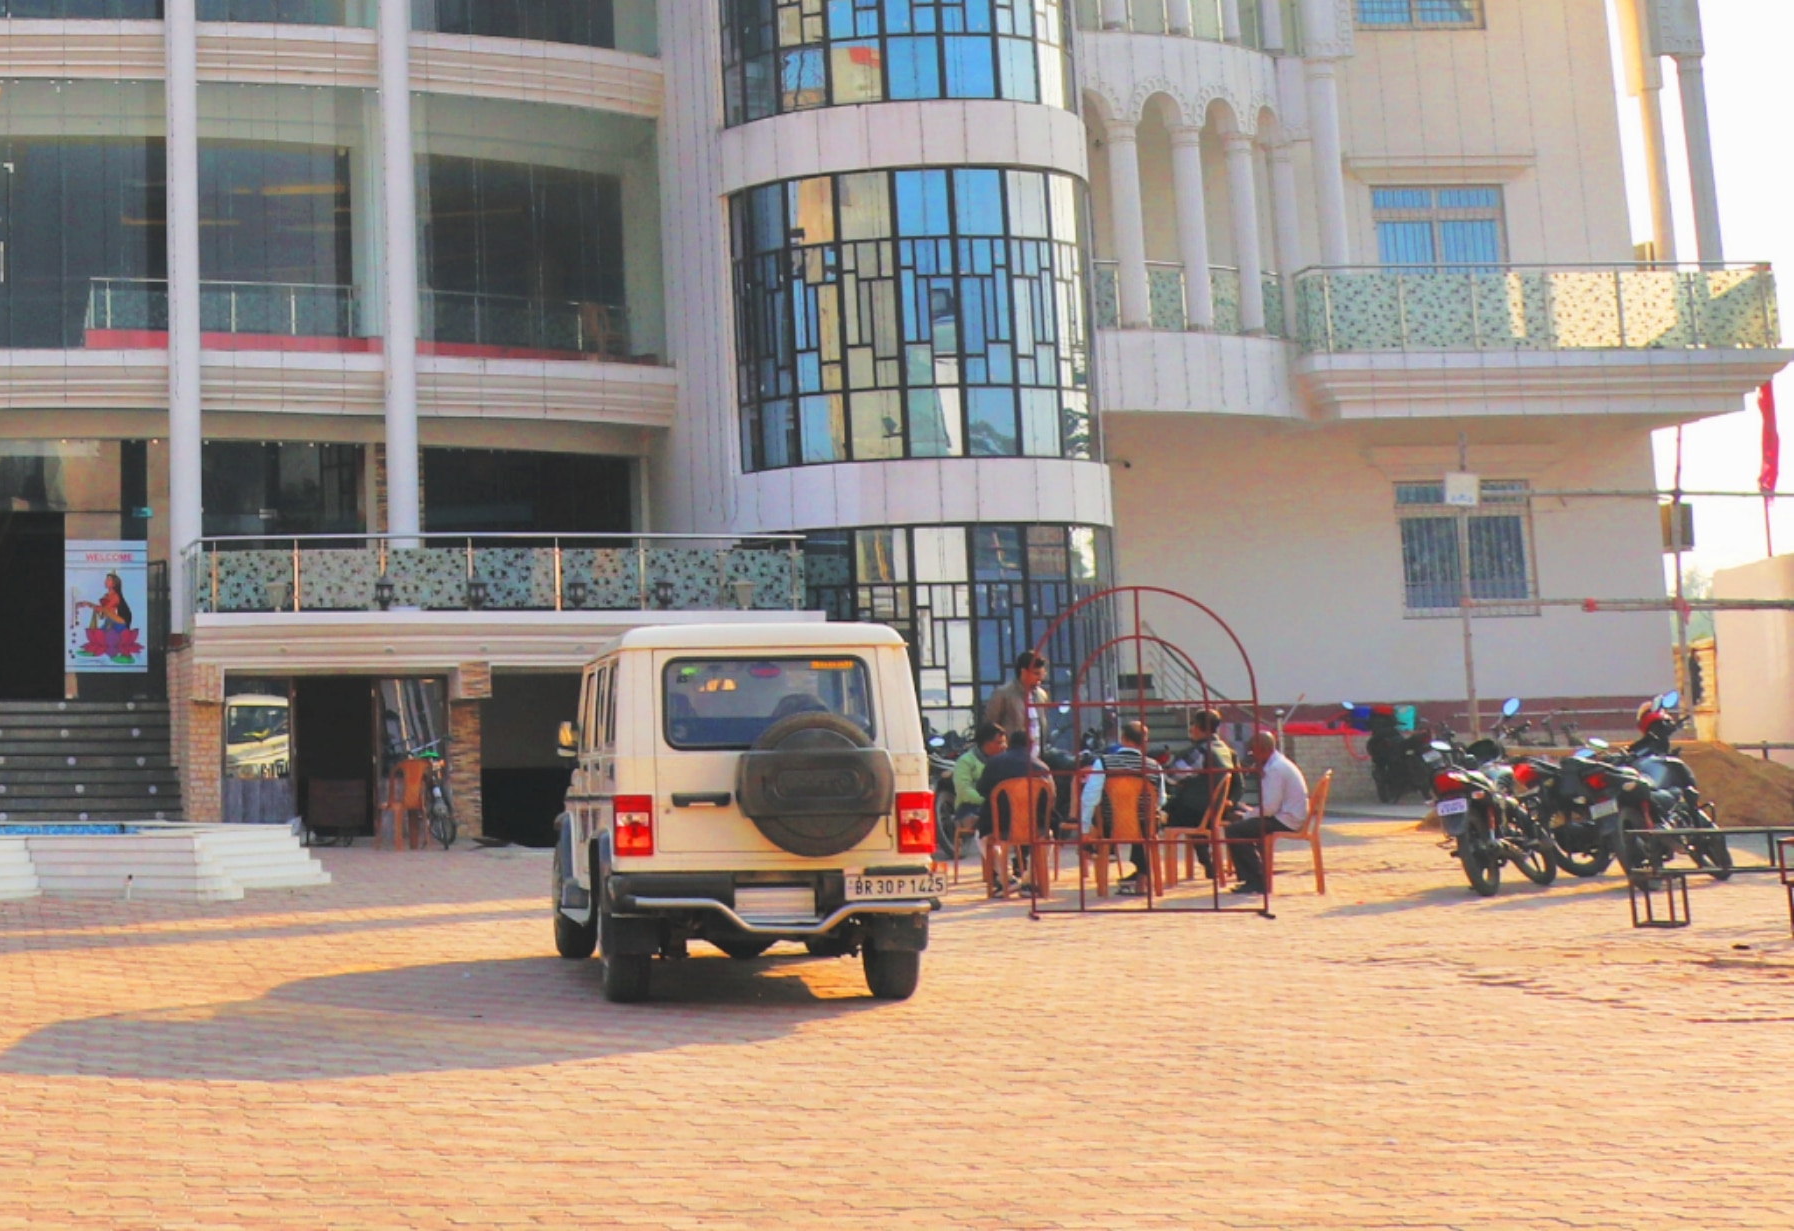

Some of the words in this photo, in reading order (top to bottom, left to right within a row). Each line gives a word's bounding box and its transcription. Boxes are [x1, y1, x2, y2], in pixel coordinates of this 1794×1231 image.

[86, 553, 133, 562] WELCOME
[855, 879, 872, 895] BR
[877, 879, 894, 894] 30
[910, 877, 944, 893] 1425
